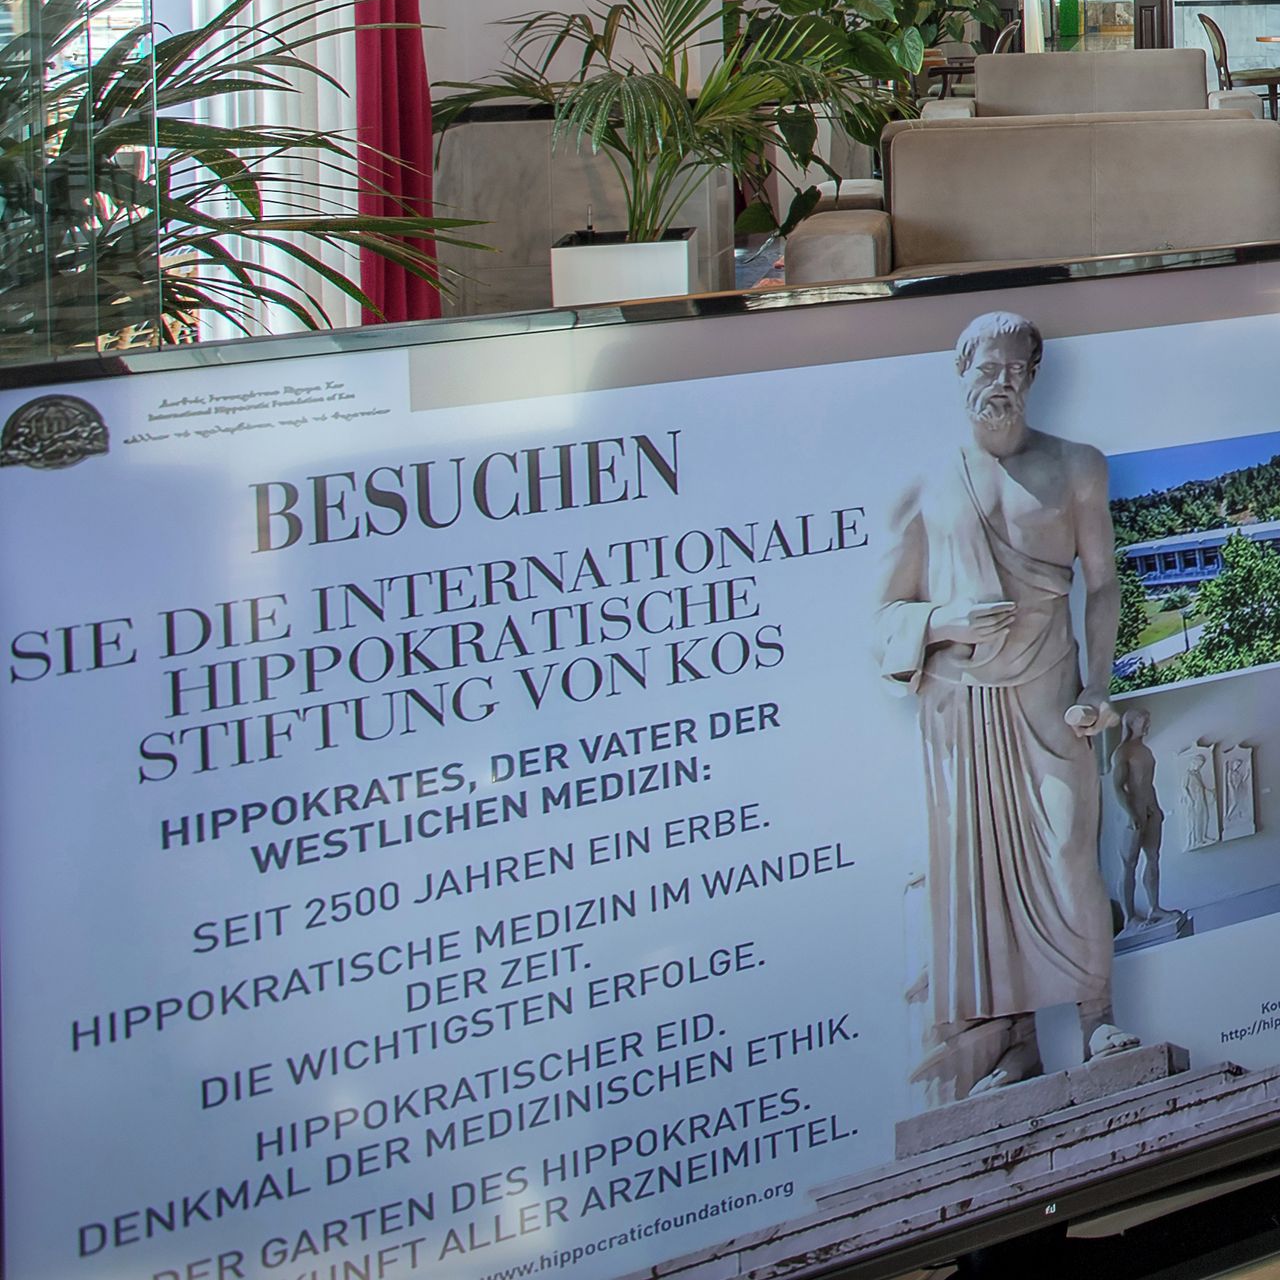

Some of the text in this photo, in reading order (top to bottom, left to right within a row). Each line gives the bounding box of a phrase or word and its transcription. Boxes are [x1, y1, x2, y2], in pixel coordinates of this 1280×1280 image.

[250, 429, 682, 554] BESUCHEN
[10, 507, 868, 683] SIE DIE INTERNATIONALE
[164, 576, 760, 718] HIPPOKRATISCHE
[139, 624, 784, 784] STIFTUNG VON KOS
[162, 702, 780, 850] HIPPOKRATES, DER VATER DER
[194, 803, 770, 953] SEIT 2500 JAHREN EIN ERBE.
[251, 756, 710, 873] WESTLICHEN MEDIZIN:
[72, 843, 854, 1051] HIPPOKRATISCHE MEDIZIN IM WANDEL
[406, 943, 590, 1013] DER ZEIT.
[202, 941, 765, 1110] DIE WICHTIGSTEN ERFOLGE.
[257, 1013, 726, 1162] HIPPOKRATISCHER EID.
[80, 1014, 858, 1257] DENKMAL DER MEDIZINISCHEN ETHIK.
[261, 1192, 434, 1268] GARTEN
[452, 1166, 528, 1214] DES
[543, 1088, 810, 1186] HIPPOKRATES.
[439, 1196, 568, 1261] ALLER
[580, 1115, 858, 1217] ARZNEIMITTEL.
